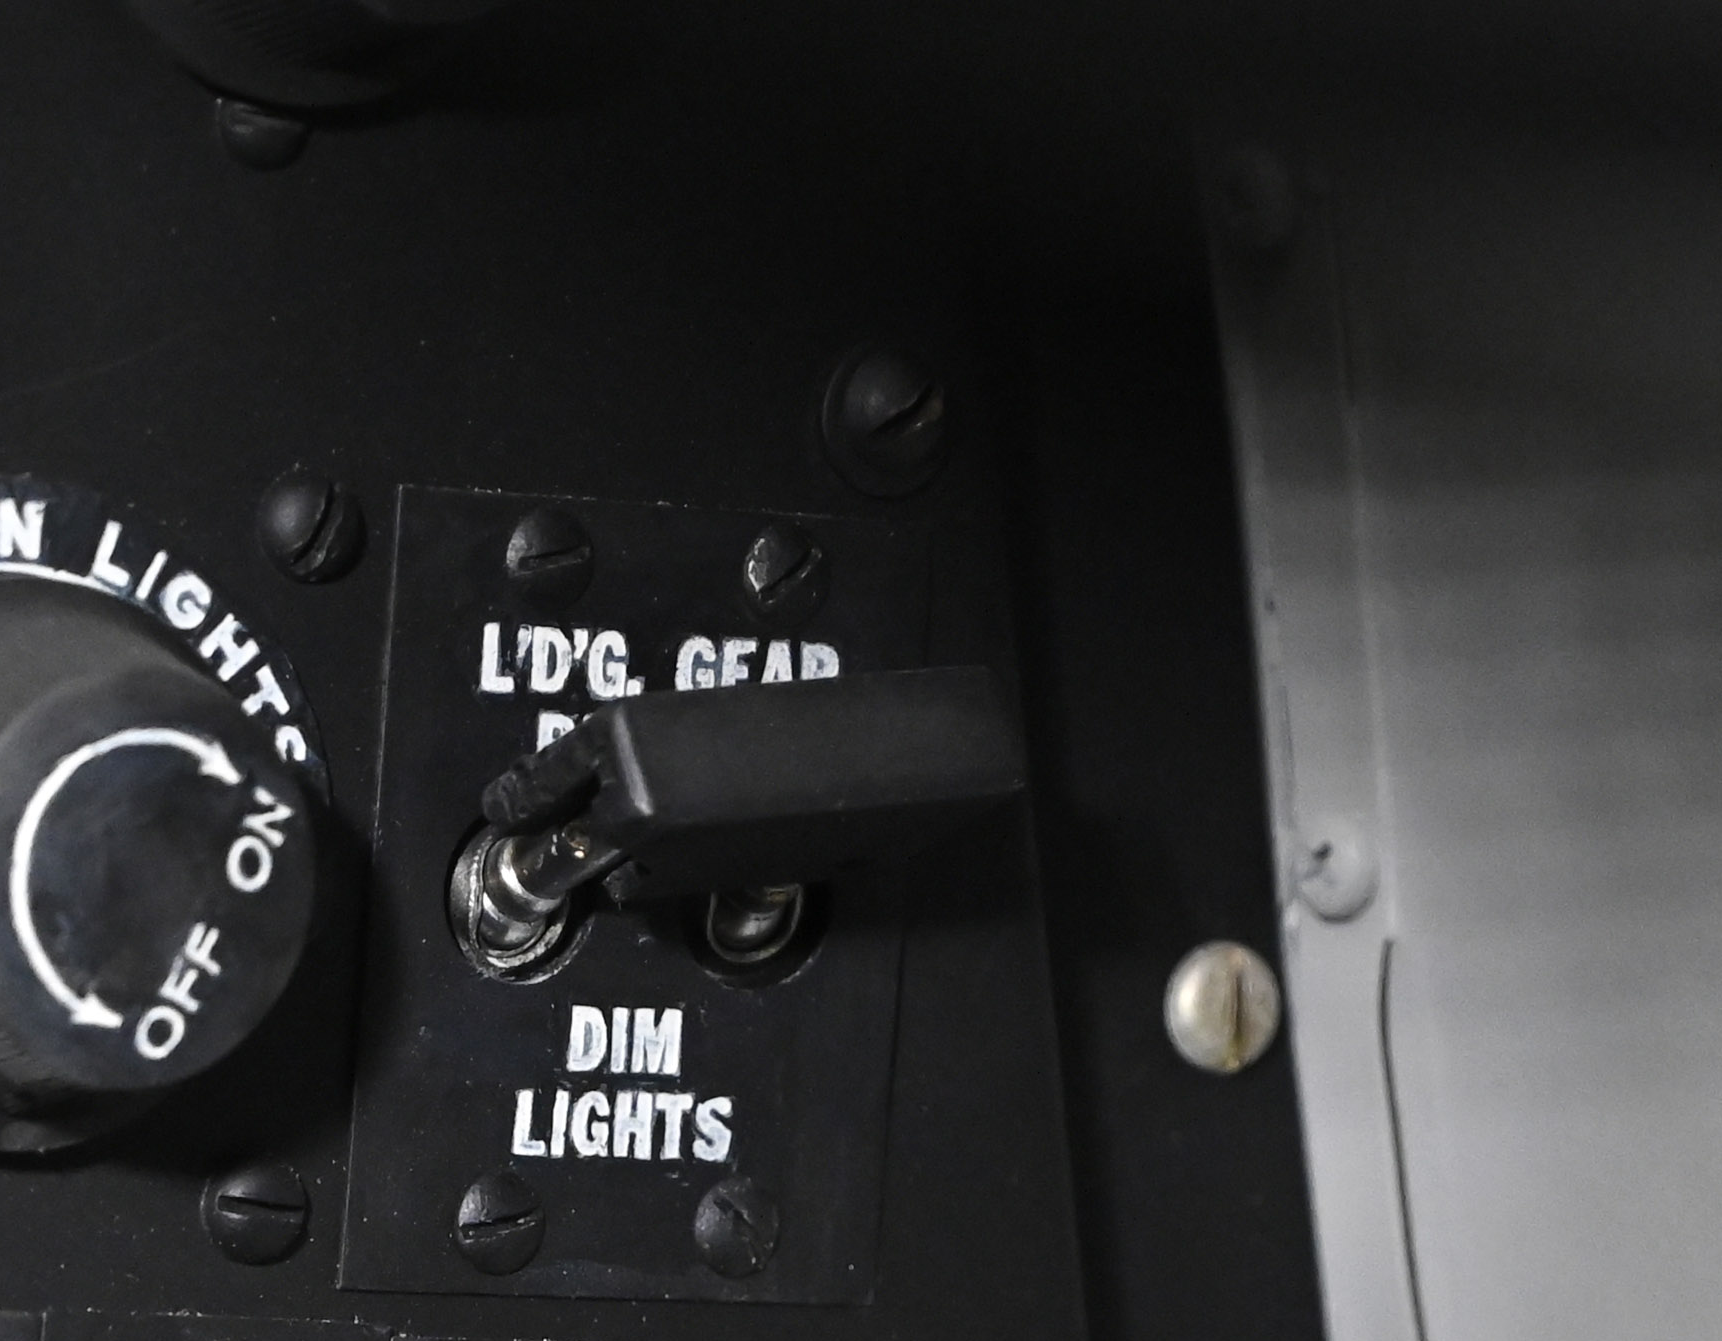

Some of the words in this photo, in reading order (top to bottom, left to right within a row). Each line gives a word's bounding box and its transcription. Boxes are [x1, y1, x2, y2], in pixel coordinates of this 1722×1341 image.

[228, 786, 294, 895] ON
[133, 920, 223, 1061] OFF
[567, 1004, 682, 1076] DIM
[512, 1089, 735, 1162] LIGHTS
